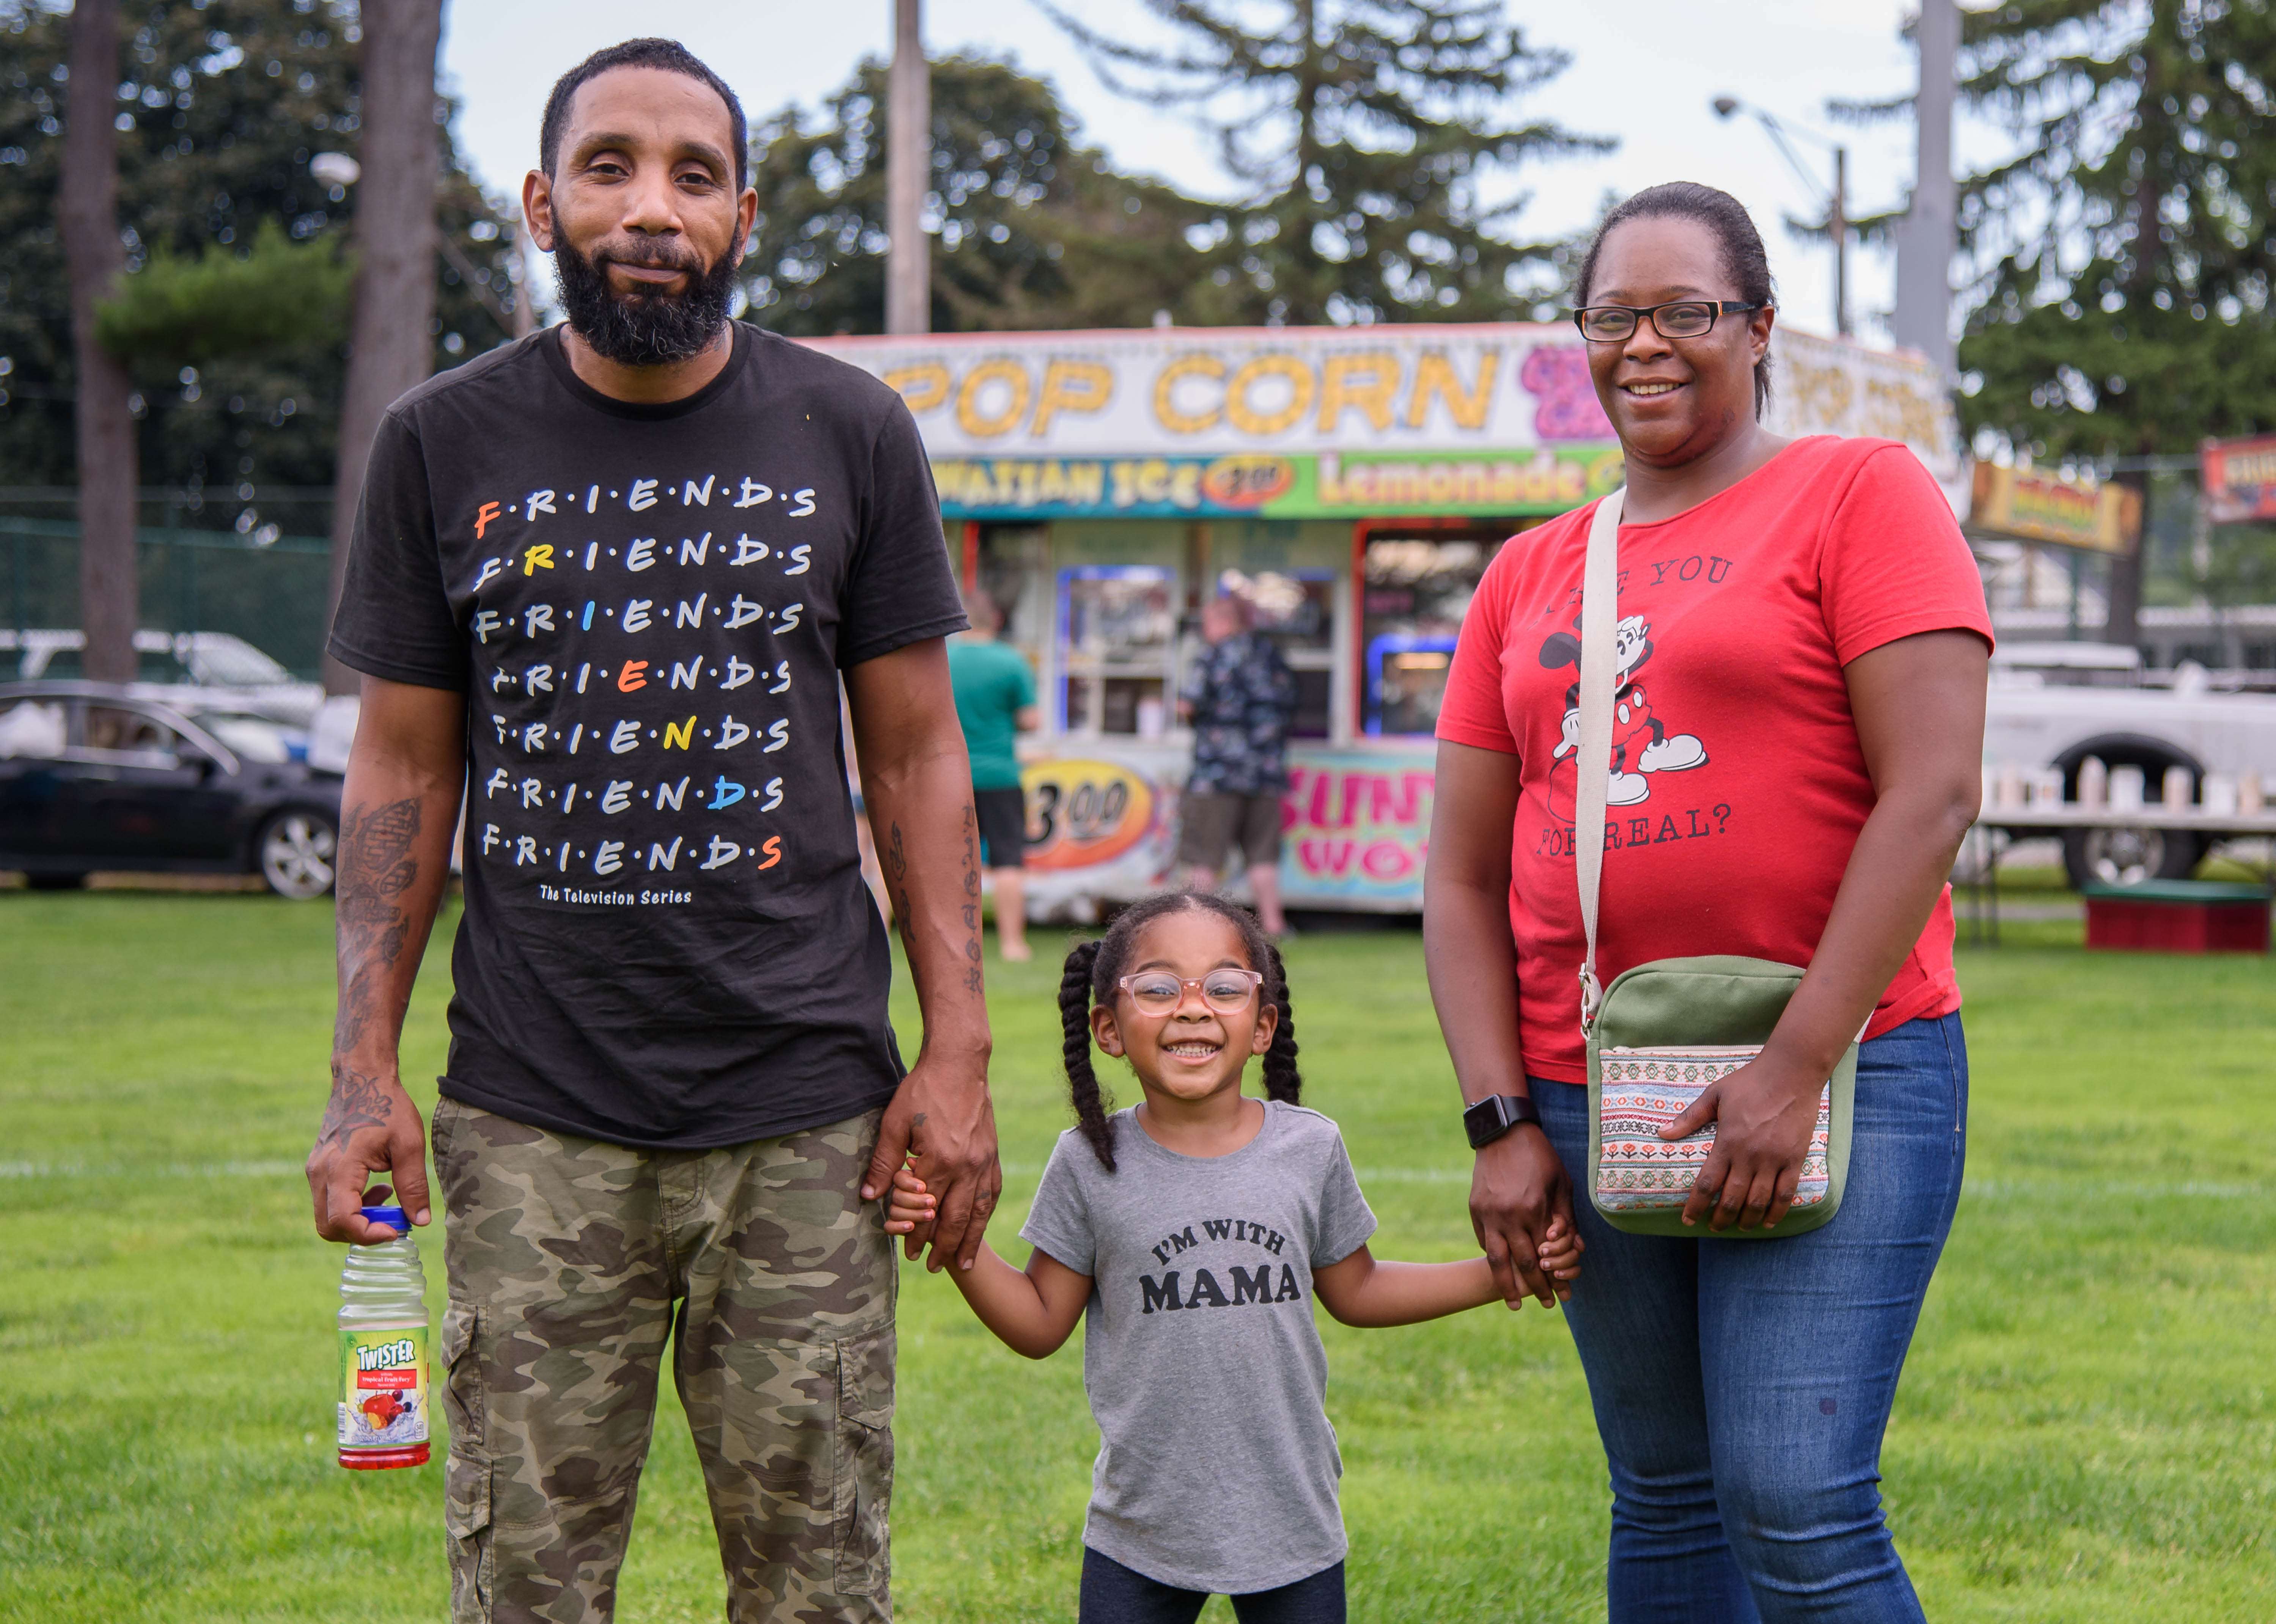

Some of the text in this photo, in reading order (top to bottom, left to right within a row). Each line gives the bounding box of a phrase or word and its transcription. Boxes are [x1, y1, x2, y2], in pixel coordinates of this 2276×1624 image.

[880, 358, 1113, 438] POP
[1152, 353, 1500, 435] CORN
[1318, 452, 1586, 506] Lemonade
[1650, 556, 1733, 586] YOU
[1603, 803, 1731, 851] REAL?
[1298, 837, 1430, 879] WO
[540, 884, 692, 905] The Television Series
[1151, 1218, 1286, 1266] I'M WITH
[1138, 1263, 1301, 1315] MAMA
